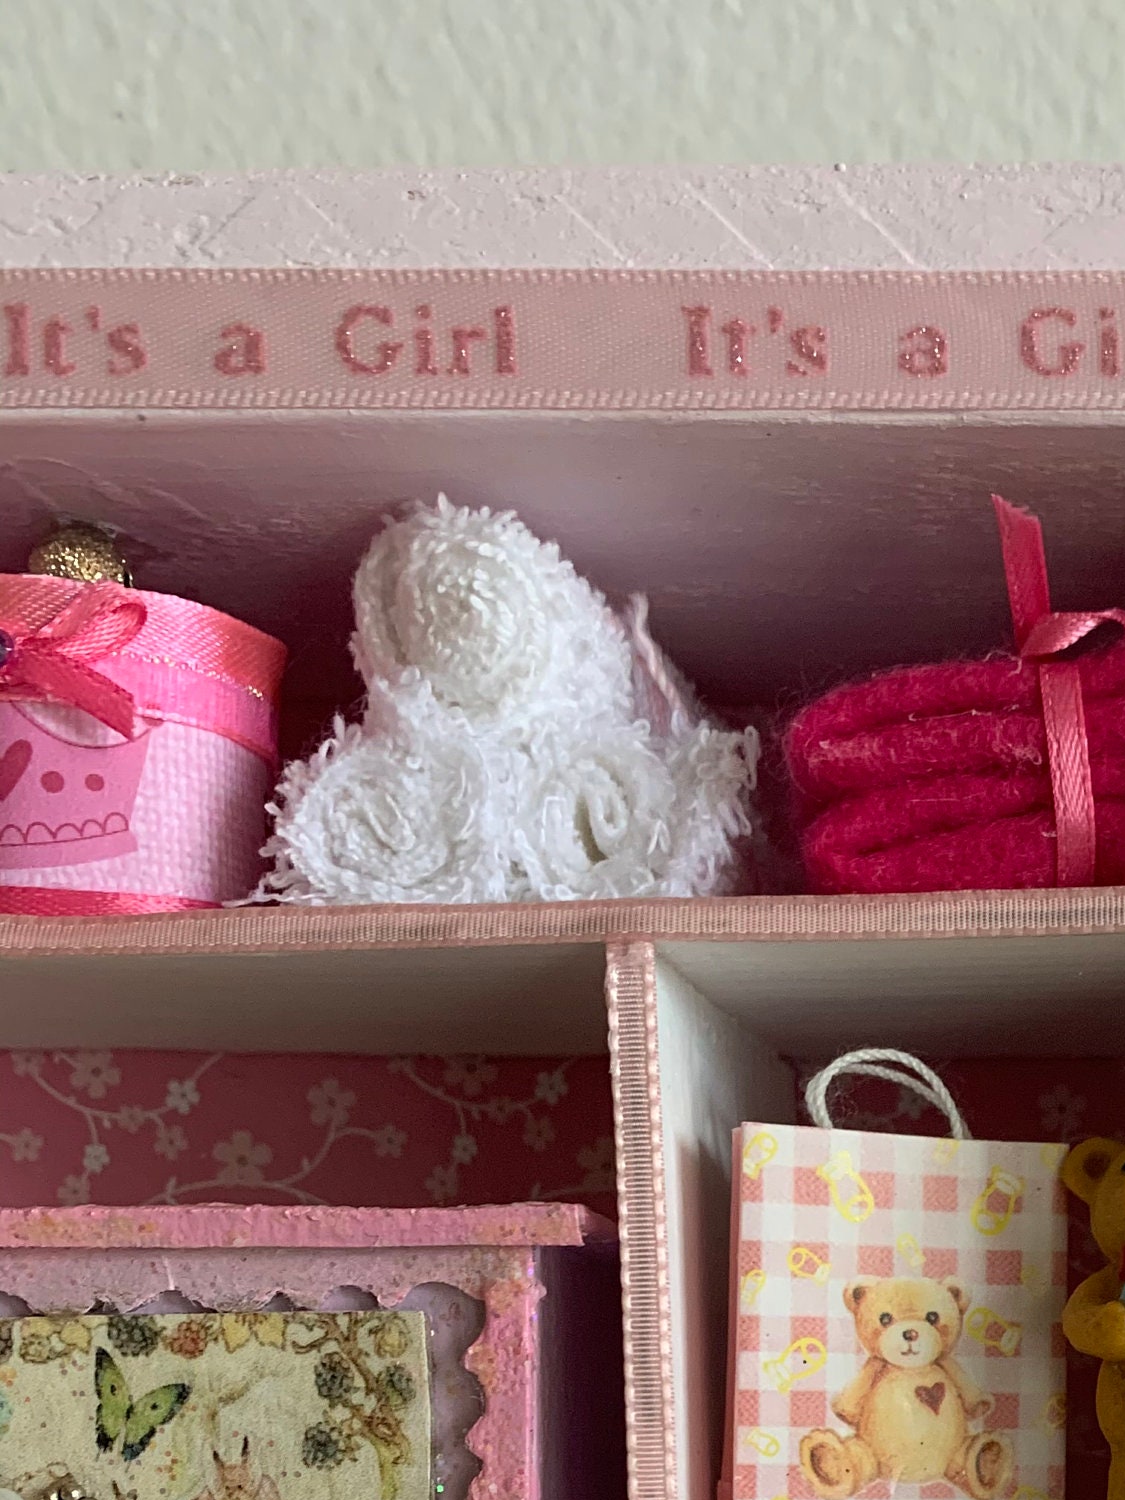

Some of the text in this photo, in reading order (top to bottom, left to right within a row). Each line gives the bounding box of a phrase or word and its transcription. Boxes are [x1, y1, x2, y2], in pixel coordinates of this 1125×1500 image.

[4, 301, 516, 377] It's a Girl
[681, 304, 829, 377] It's
[899, 325, 948, 377] a
